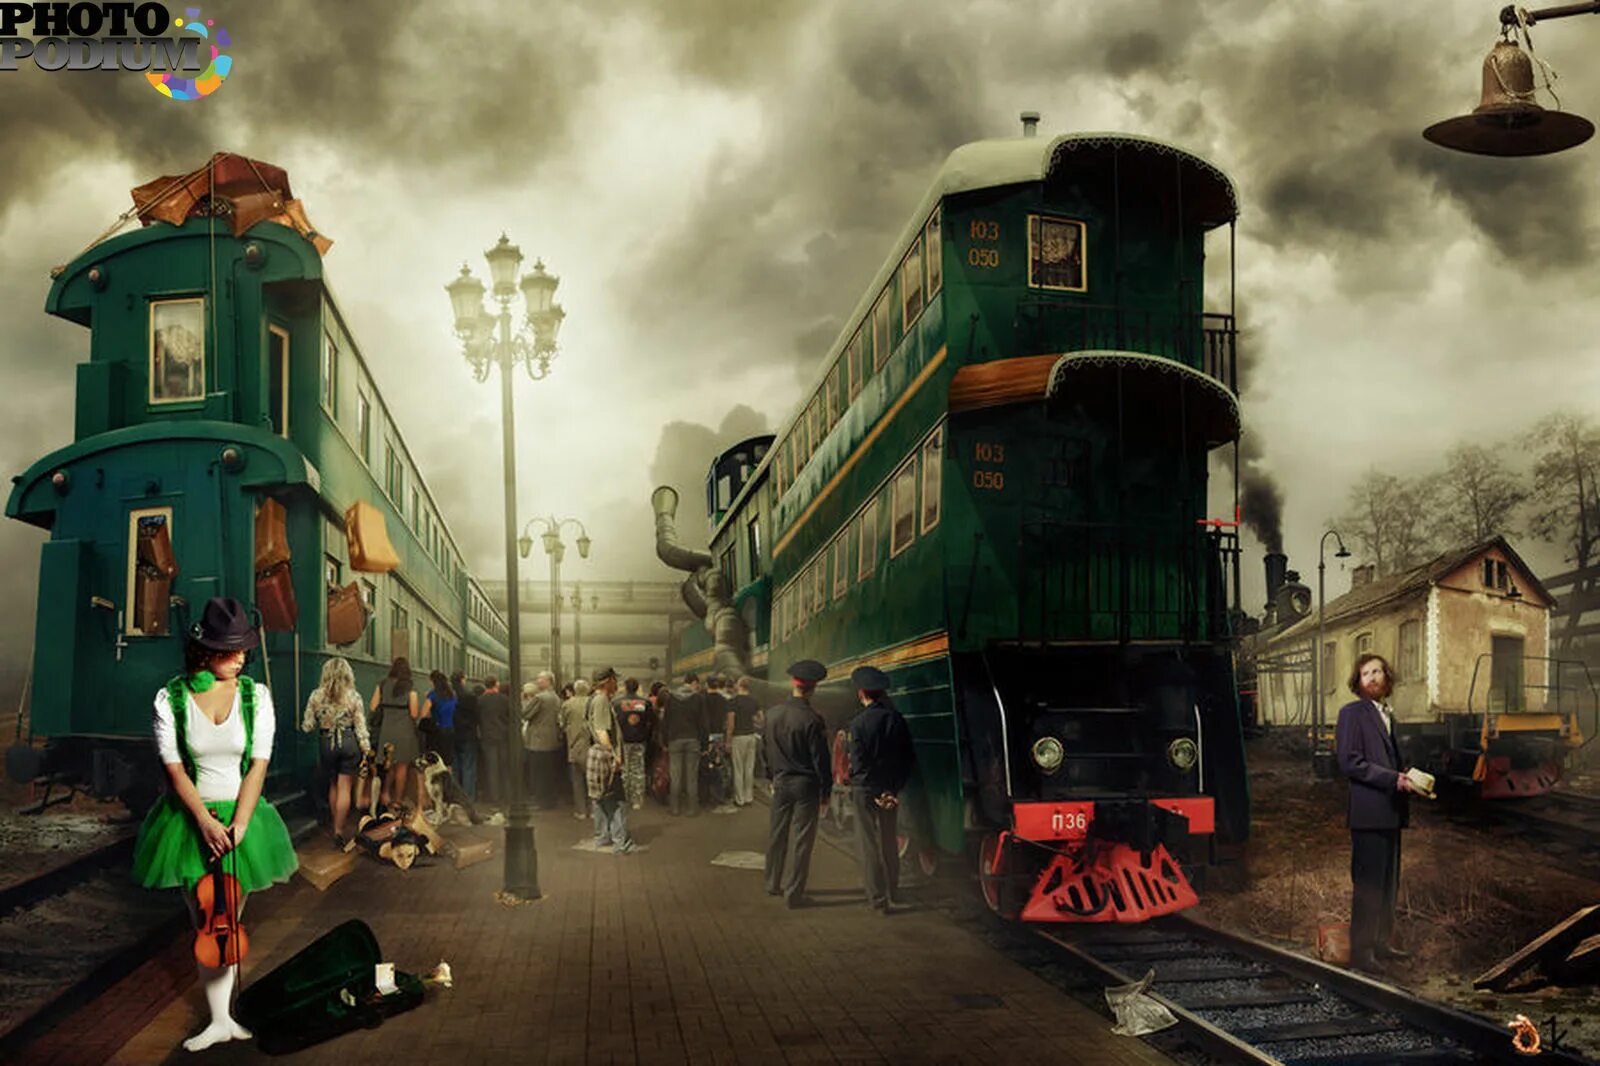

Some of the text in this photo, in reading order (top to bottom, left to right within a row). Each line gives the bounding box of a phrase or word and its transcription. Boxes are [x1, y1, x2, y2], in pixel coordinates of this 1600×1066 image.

[968, 248, 998, 267] 050
[974, 470, 1003, 490] 050
[1052, 813, 1086, 829] П36
